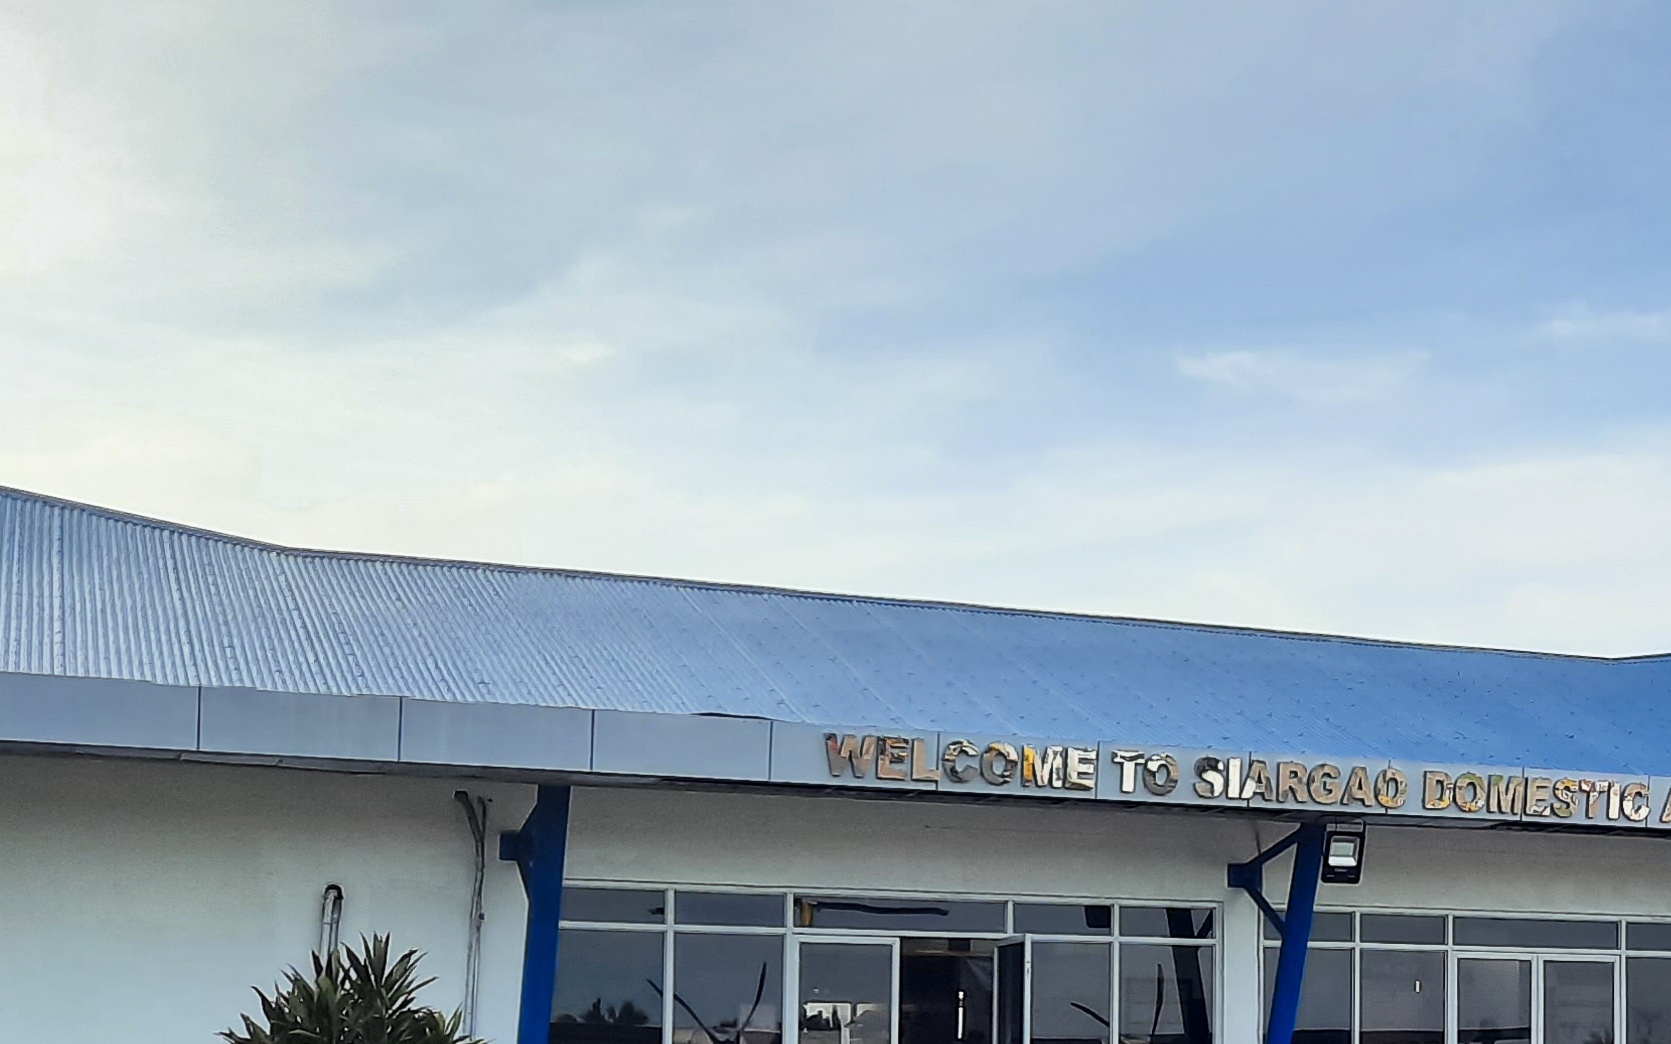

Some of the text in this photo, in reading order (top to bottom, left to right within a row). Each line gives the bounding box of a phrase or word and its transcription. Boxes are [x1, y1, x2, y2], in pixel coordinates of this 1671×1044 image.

[824, 732, 1099, 791] WELCOME
[1112, 748, 1179, 796] TO
[1193, 755, 1407, 808] SIARGAO
[1422, 769, 1650, 822] DOMESTIC
